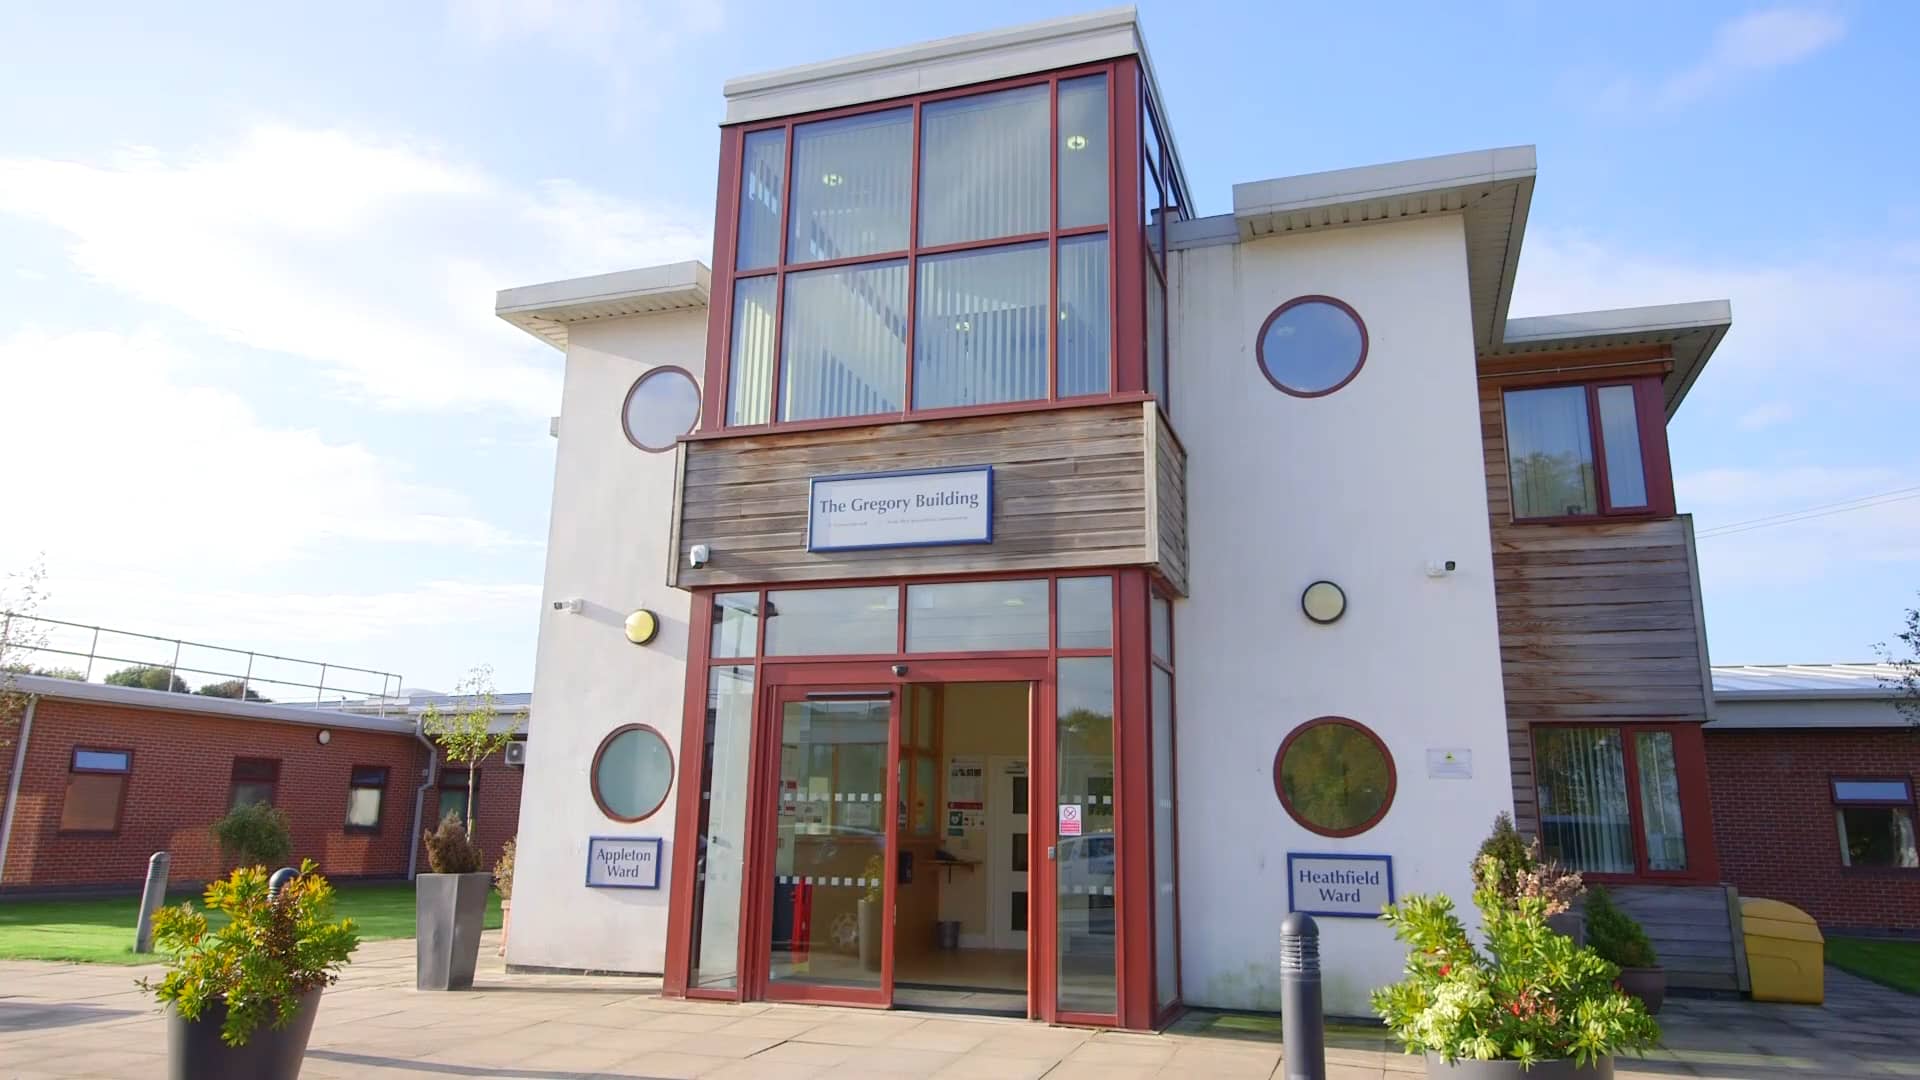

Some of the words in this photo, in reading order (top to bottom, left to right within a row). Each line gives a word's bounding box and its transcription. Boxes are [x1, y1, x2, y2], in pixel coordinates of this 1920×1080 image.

[820, 499, 846, 513] The
[851, 498, 910, 514] Gregory
[916, 491, 979, 508] Building
[597, 848, 651, 864] Appleton
[608, 865, 639, 878] Ward
[1300, 870, 1380, 885] Heathfield
[1319, 888, 1360, 902] Ward
